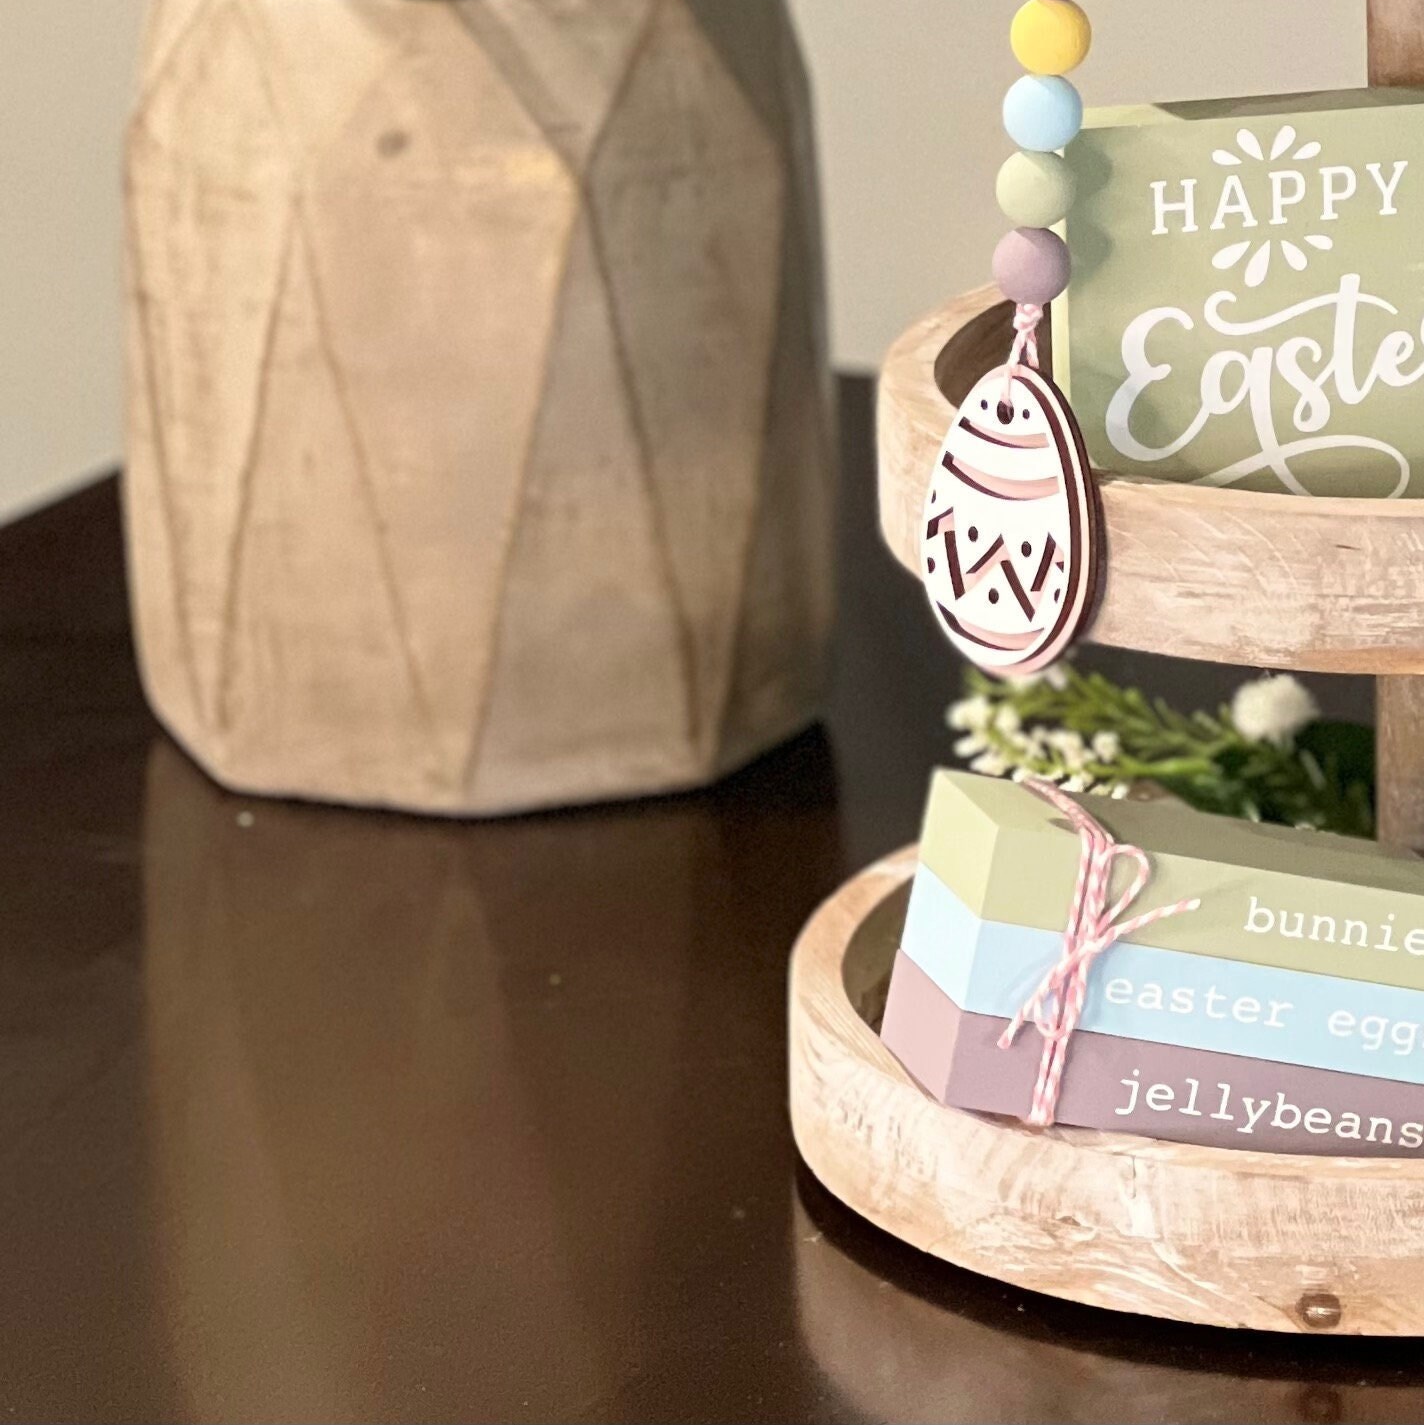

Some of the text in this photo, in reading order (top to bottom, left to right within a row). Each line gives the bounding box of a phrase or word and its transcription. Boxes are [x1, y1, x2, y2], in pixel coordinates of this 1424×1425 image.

[1149, 160, 1409, 236] HAPPY
[1104, 975, 1293, 1029] easter
[1114, 1069, 1424, 1149] jellybeans
